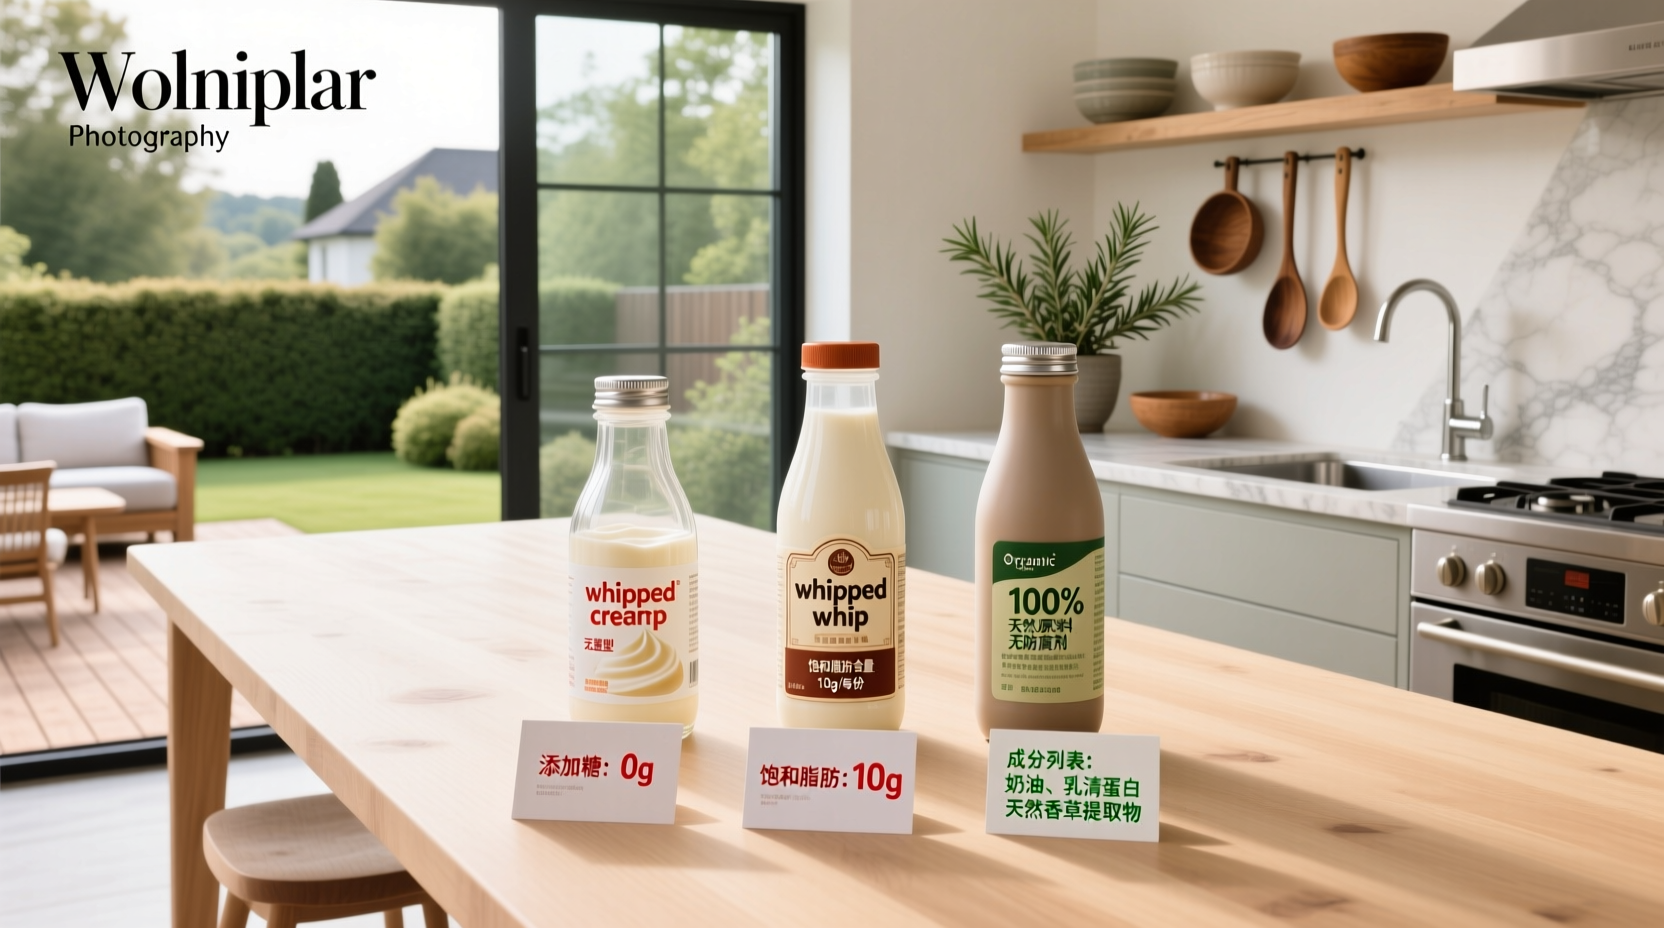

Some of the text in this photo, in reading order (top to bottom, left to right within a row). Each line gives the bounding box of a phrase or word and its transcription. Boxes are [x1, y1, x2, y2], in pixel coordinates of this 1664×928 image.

[585, 580, 676, 609] whipped
[795, 577, 887, 606] whipped
[1008, 586, 1085, 616] 100%
[812, 605, 869, 632] whip
[620, 752, 655, 788] 0g
[1004, 798, 1142, 824] 天然香草提取物
